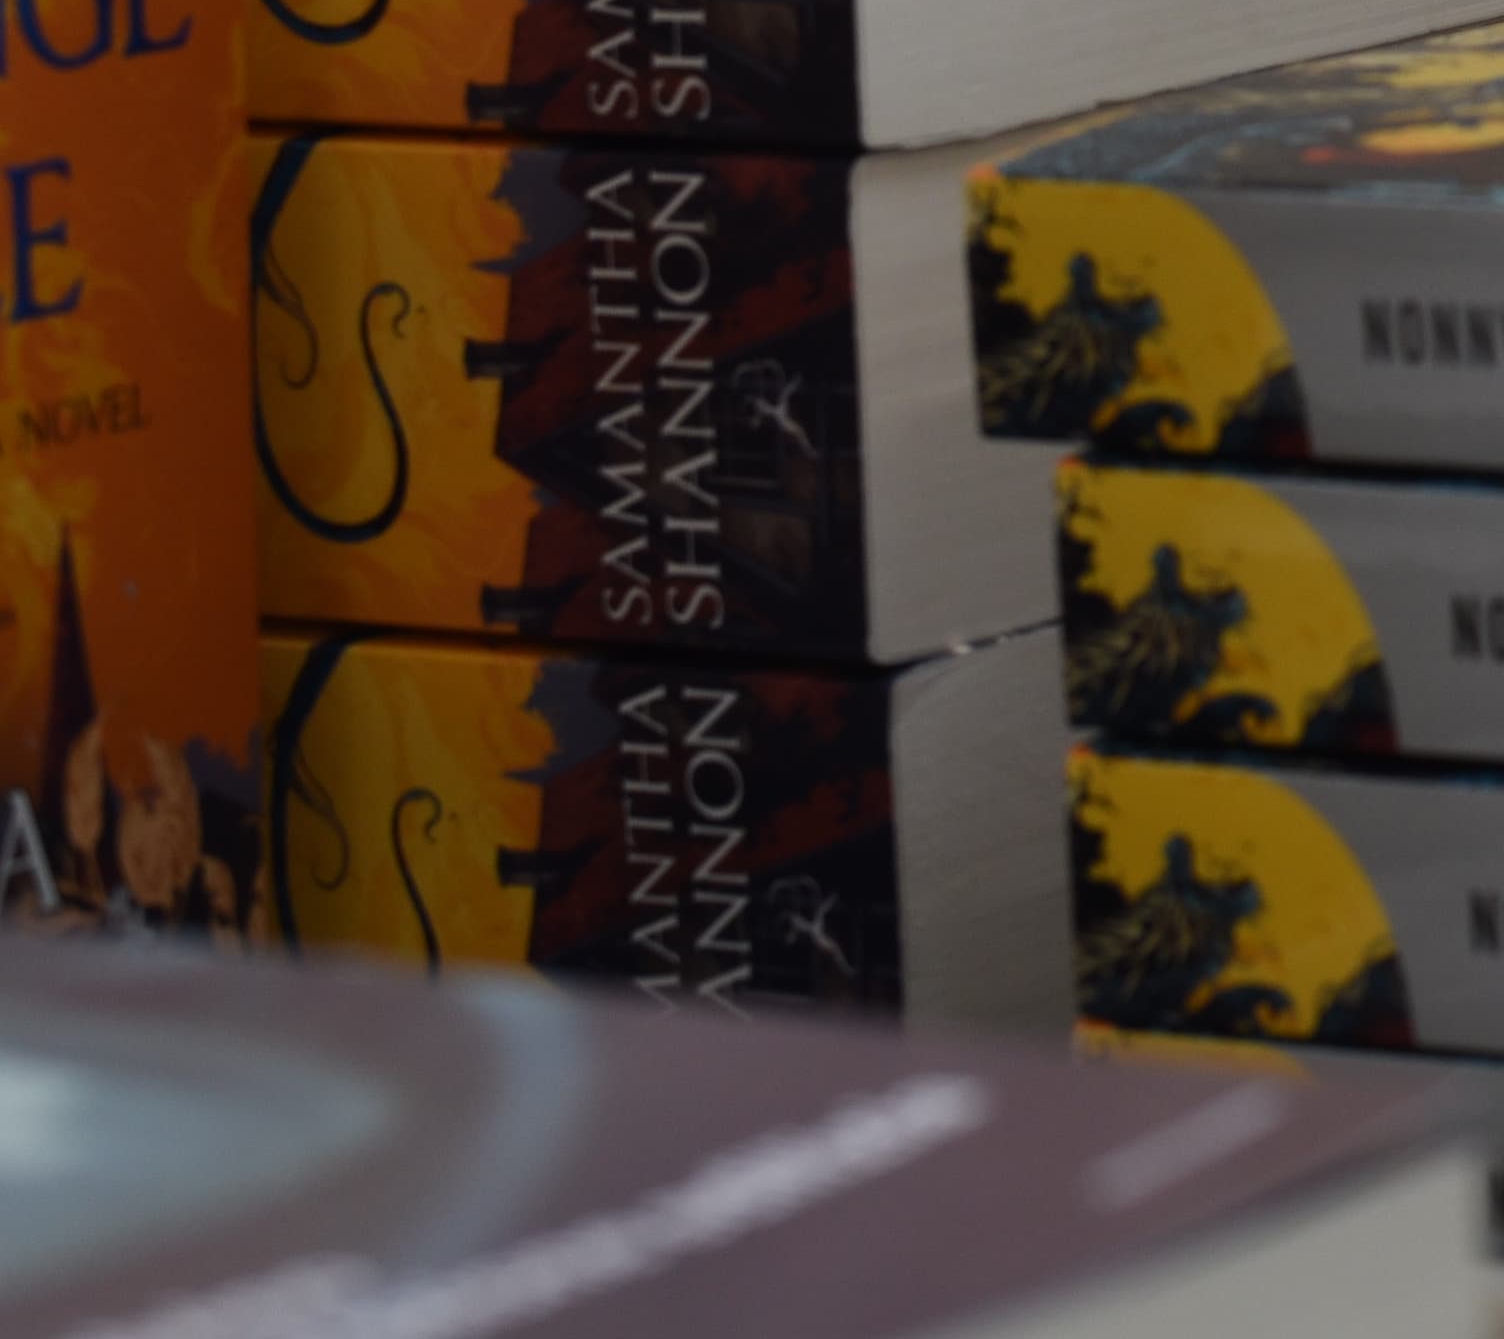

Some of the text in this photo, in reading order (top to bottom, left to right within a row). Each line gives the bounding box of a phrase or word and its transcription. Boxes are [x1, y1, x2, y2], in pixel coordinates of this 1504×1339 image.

[17, 381, 152, 447] NOVEL
[586, 168, 652, 629] SAMANTHA
[648, 169, 726, 631] SHANNON
[618, 684, 681, 1016] MANTHA
[680, 685, 753, 1021] ANNON
